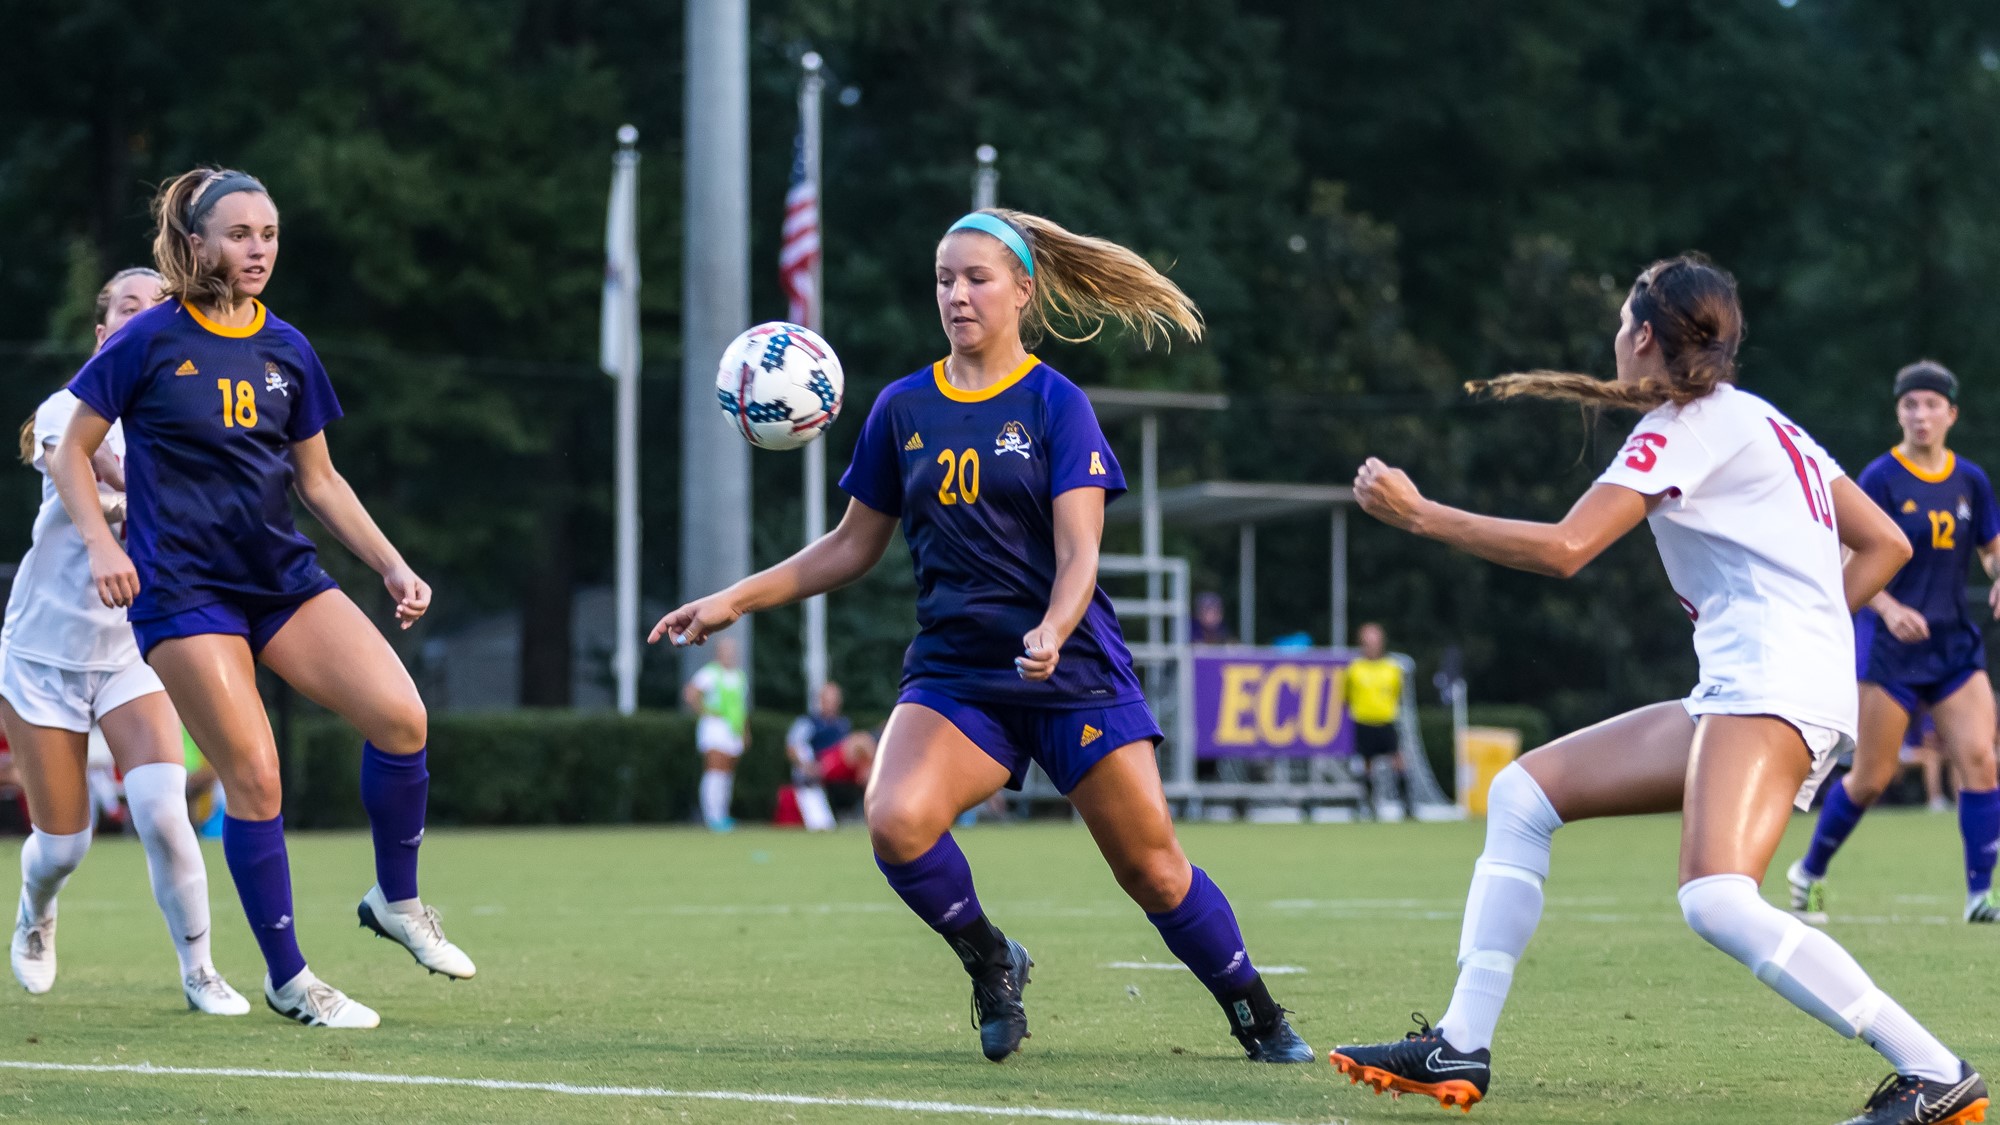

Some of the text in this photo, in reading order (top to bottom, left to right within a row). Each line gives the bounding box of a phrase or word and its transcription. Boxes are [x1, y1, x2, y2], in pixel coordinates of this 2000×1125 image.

[217, 378, 258, 429] 18
[937, 448, 980, 505] 20
[1089, 451, 1107, 476] A
[1928, 509, 1956, 549] 12
[1214, 663, 1348, 747] ECU
